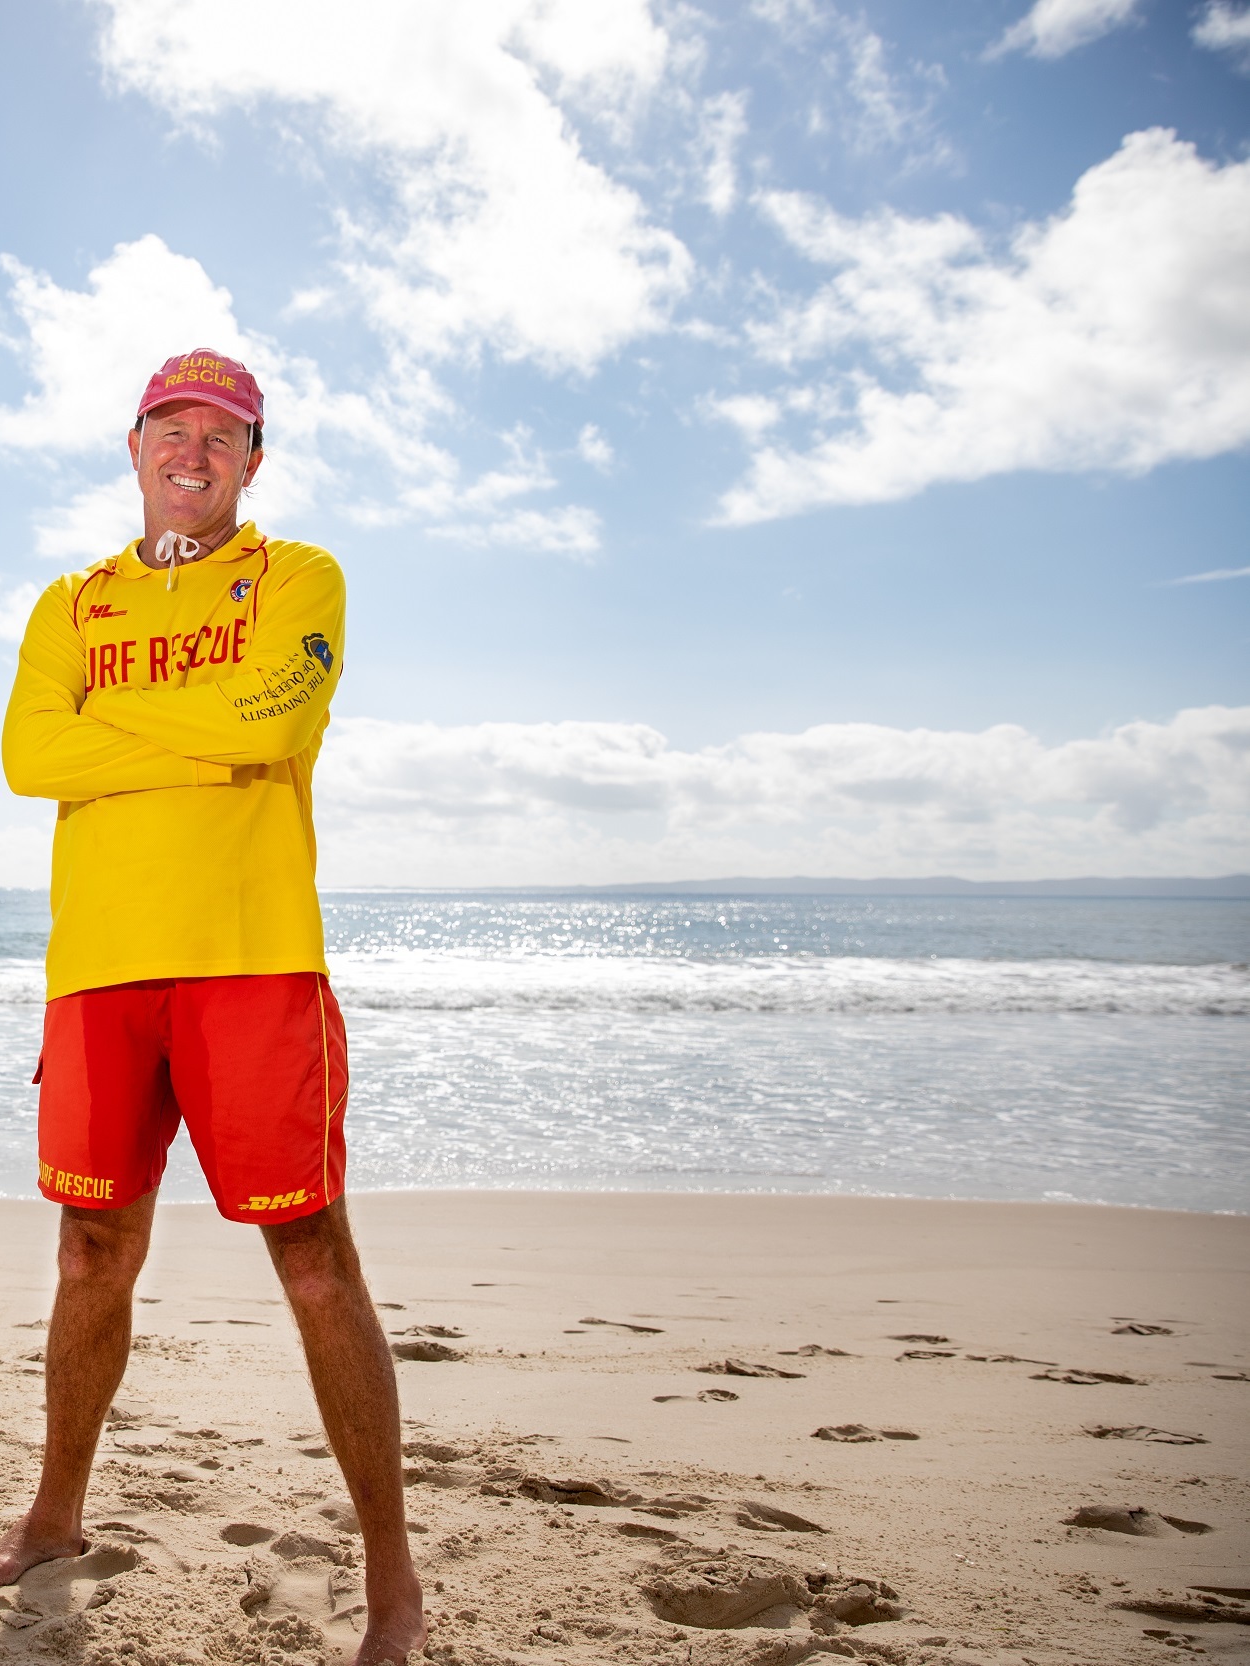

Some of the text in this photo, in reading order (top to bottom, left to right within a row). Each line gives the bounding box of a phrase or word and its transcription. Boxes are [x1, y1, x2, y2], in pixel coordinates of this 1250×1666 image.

[178, 357, 227, 371] SURF
[165, 369, 237, 392] RESCUE
[86, 618, 247, 693] URF RESCUE
[234, 659, 316, 708] OF QUEENSLAND
[240, 671, 325, 722] THE UNIVERSITY
[55, 1170, 115, 1200] RESCUE
[248, 1188, 310, 1211] DHL
